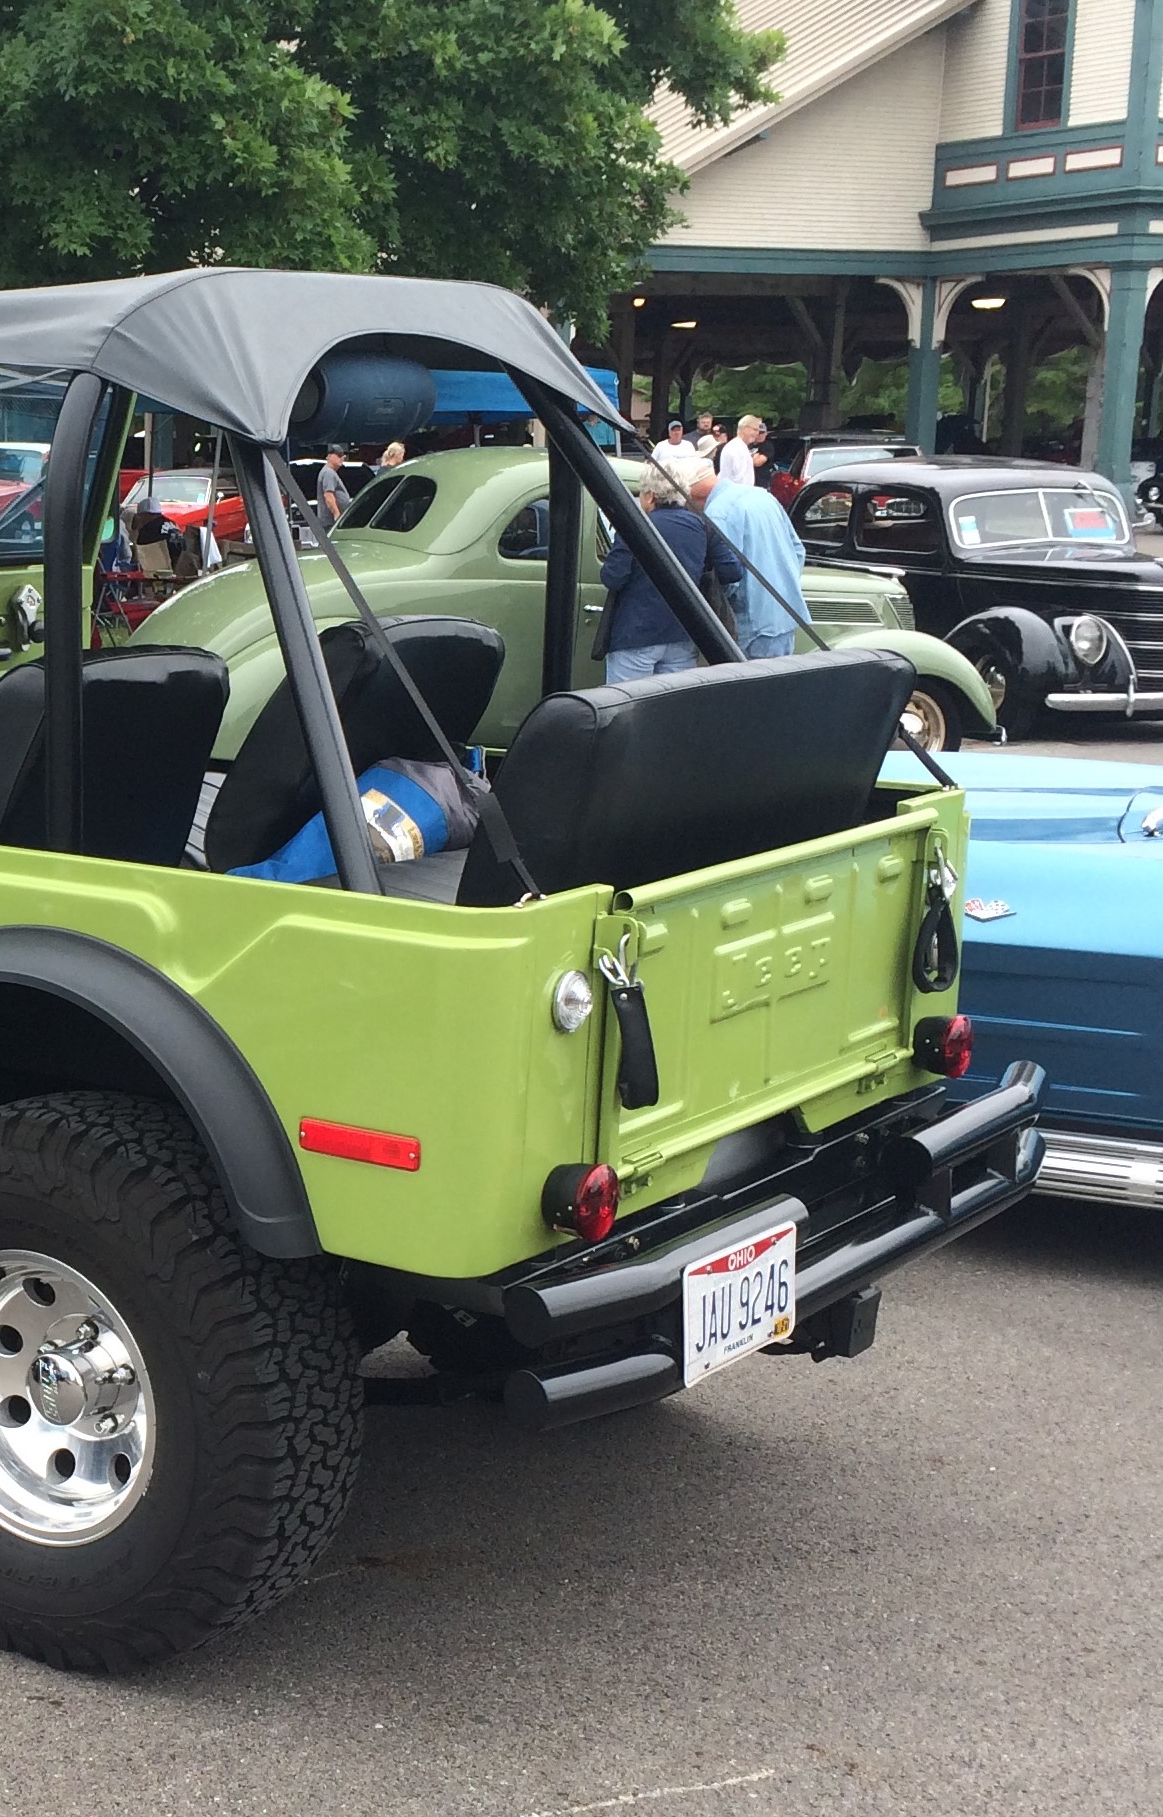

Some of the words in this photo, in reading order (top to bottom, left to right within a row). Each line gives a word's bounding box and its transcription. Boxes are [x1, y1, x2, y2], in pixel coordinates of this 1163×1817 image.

[727, 1245, 756, 1271] OHIO
[695, 1283, 733, 1353] JAU
[738, 1258, 789, 1331] 9246
[724, 1333, 754, 1353] FRANKLIN
